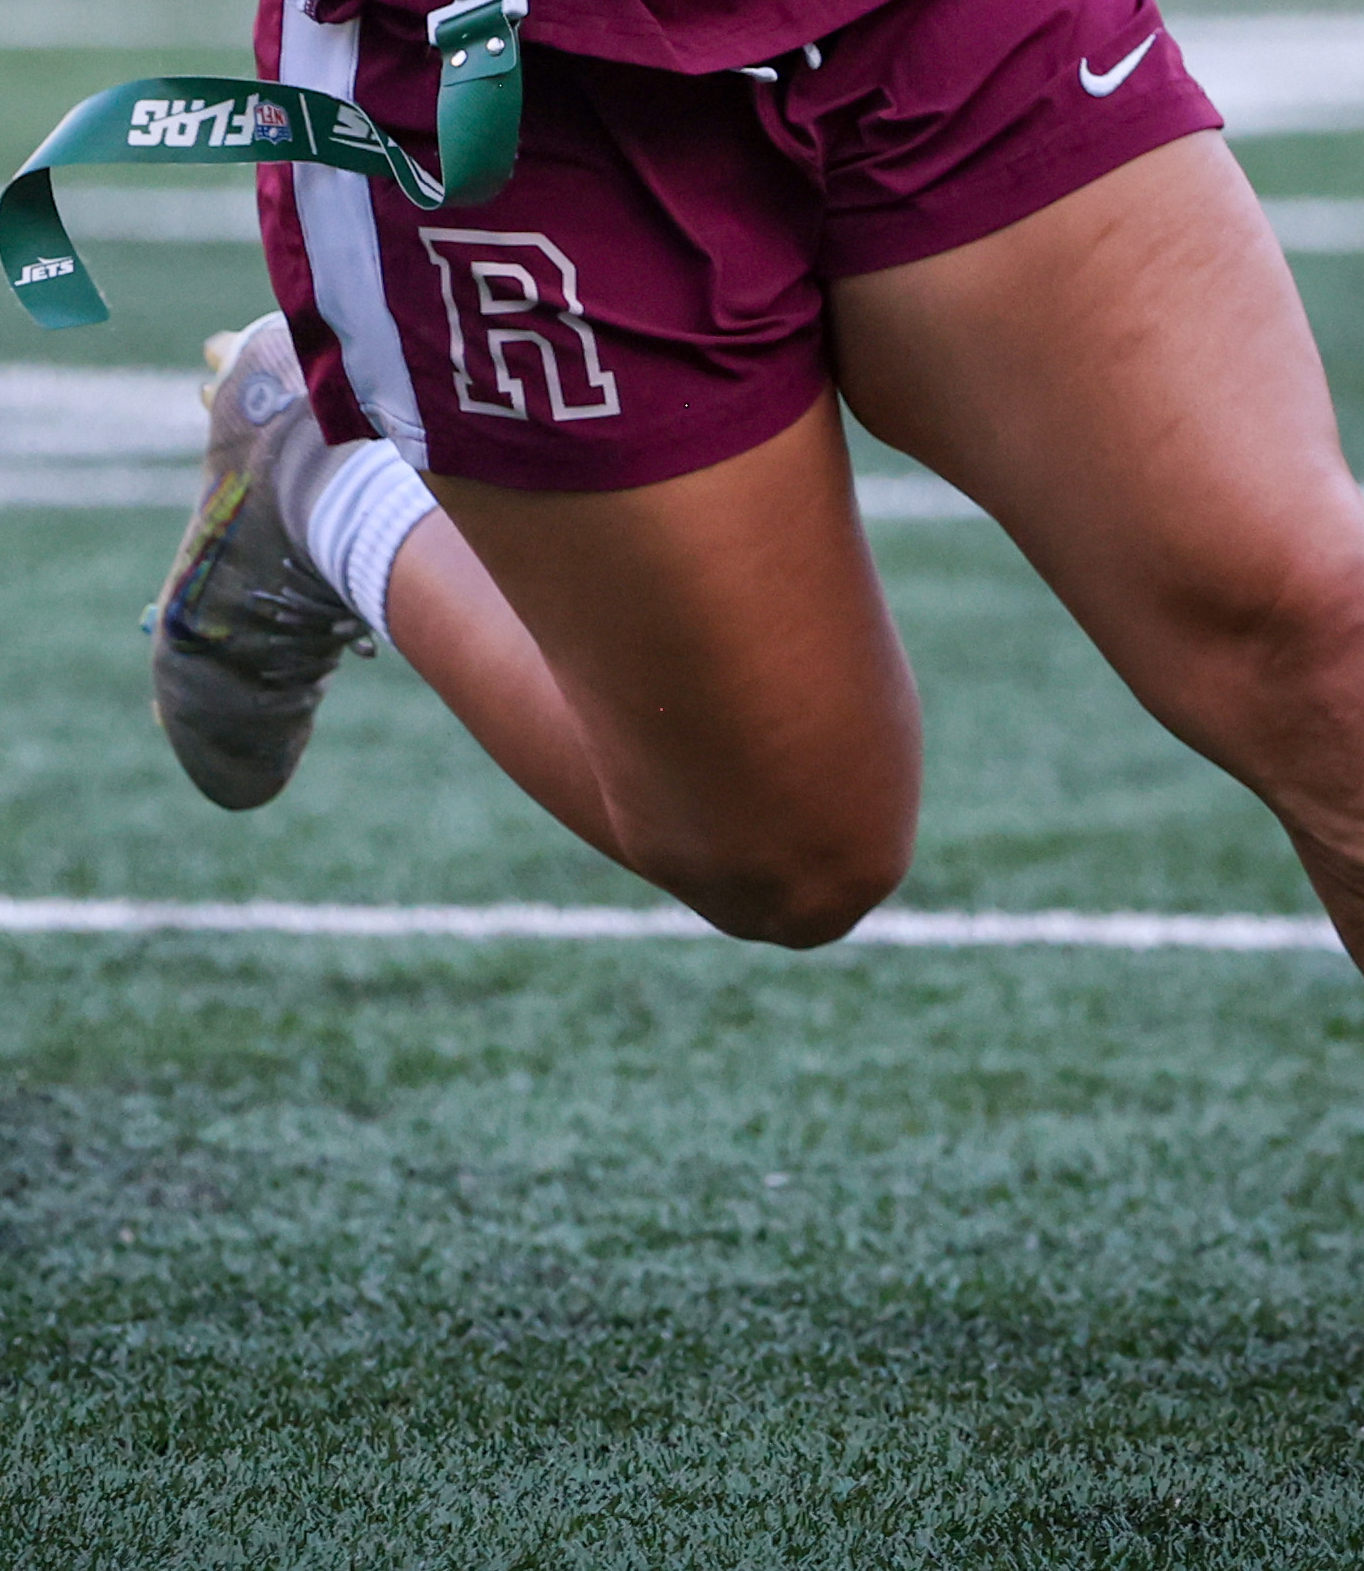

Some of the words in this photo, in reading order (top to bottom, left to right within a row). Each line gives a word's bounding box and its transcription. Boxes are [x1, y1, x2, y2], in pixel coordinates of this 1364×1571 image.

[127, 93, 259, 146] FLAG
[255, 104, 285, 126] NFL
[14, 256, 74, 286] JETS
[418, 226, 621, 422] R
